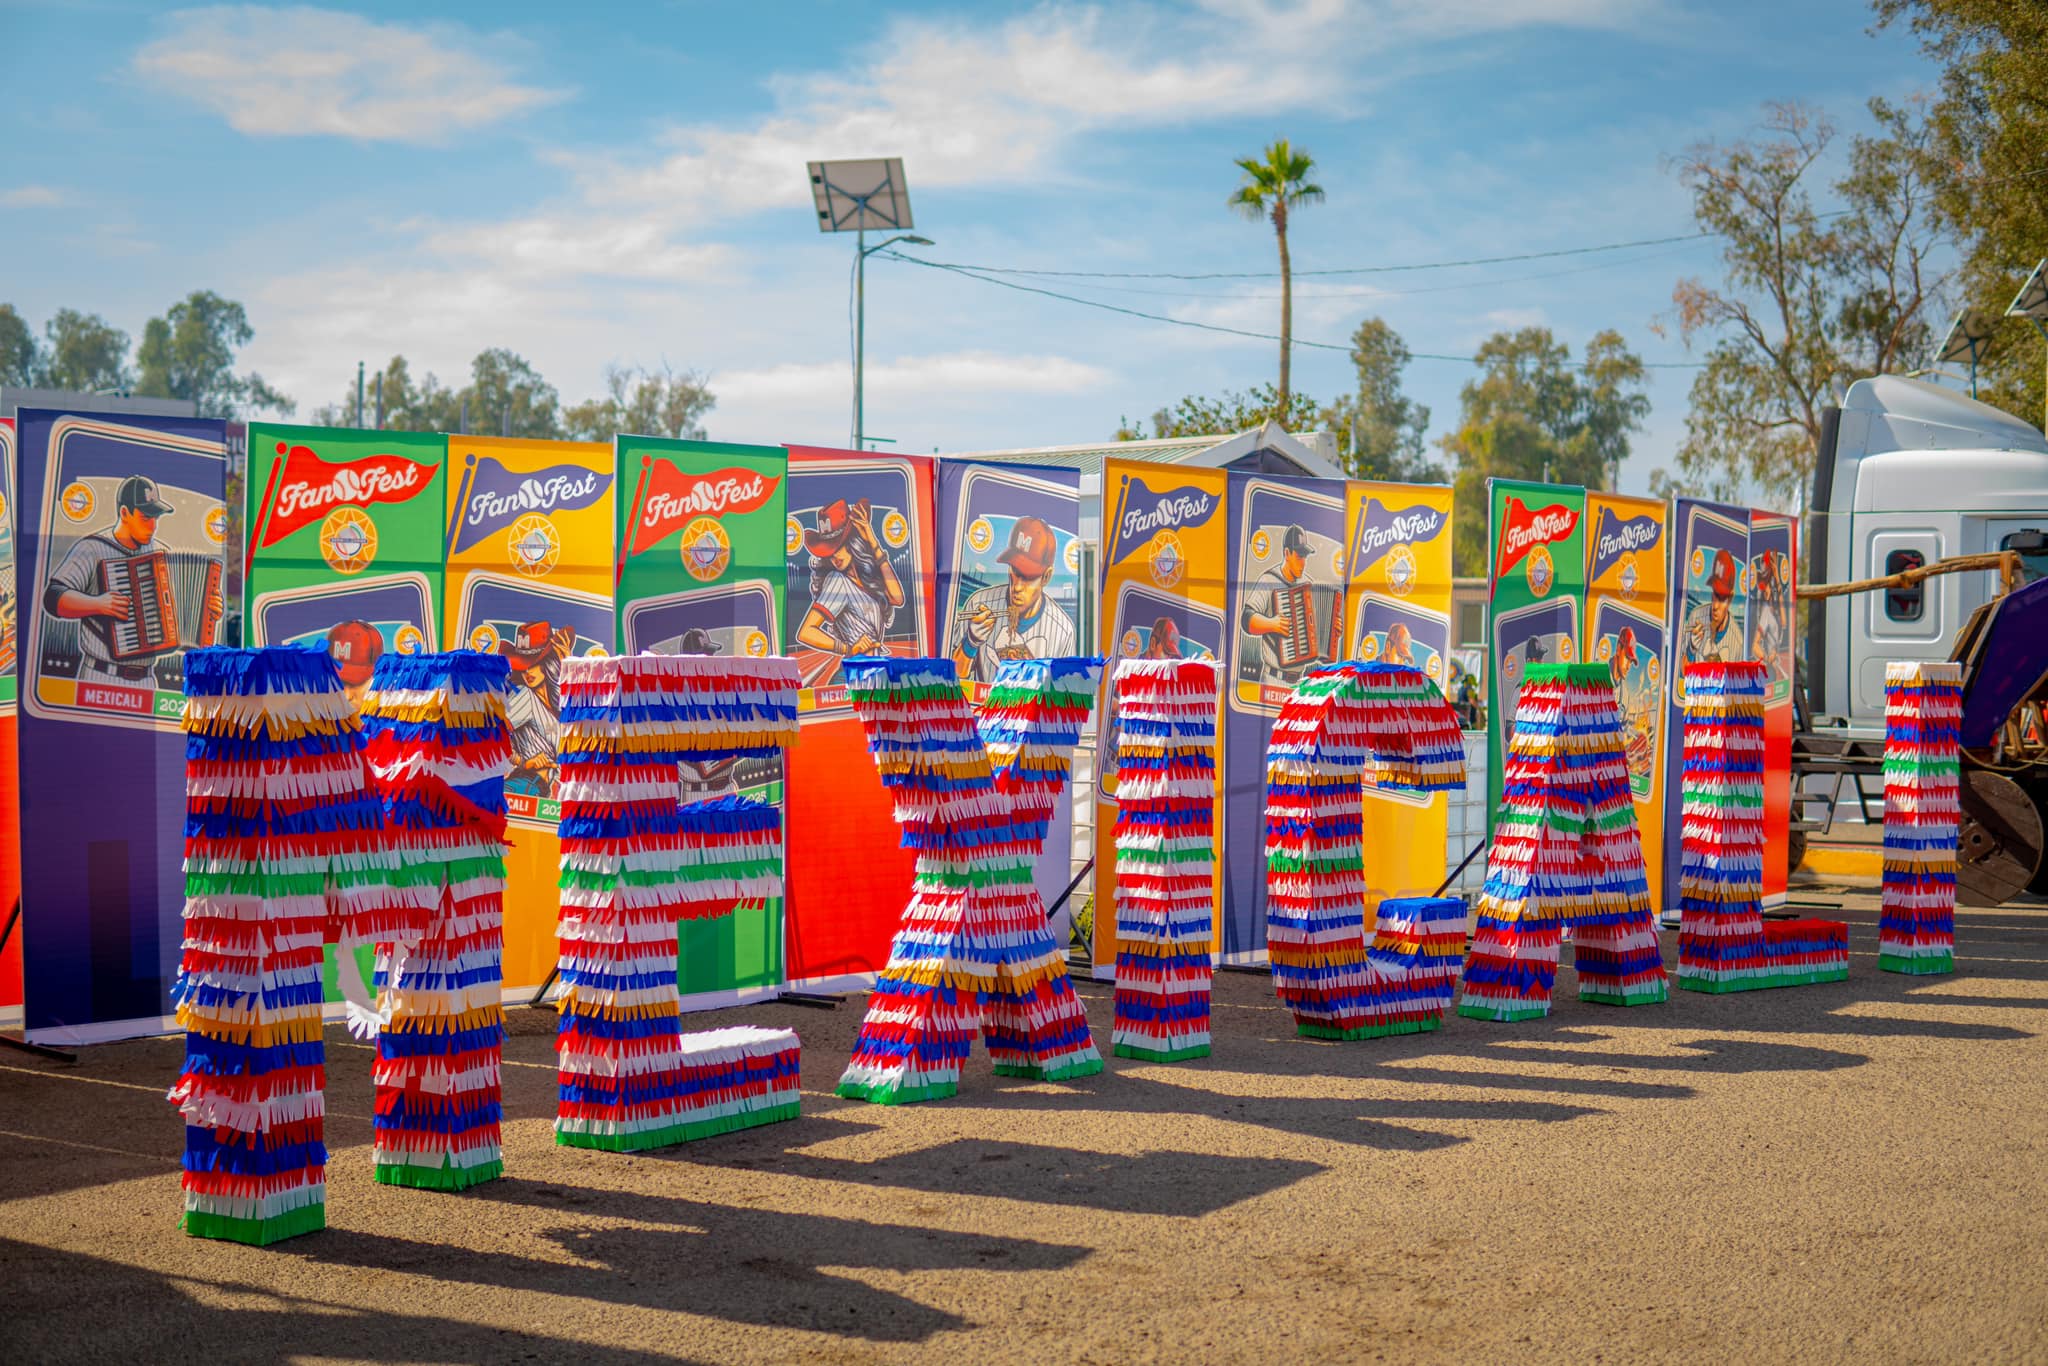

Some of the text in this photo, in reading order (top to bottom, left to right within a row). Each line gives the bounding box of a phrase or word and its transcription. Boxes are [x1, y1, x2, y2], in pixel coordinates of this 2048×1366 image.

[1016, 532, 1033, 553] M
[334, 641, 352, 660] M
[84, 688, 187, 713] MEXICALI 202
[507, 797, 561, 817] CALI 202
